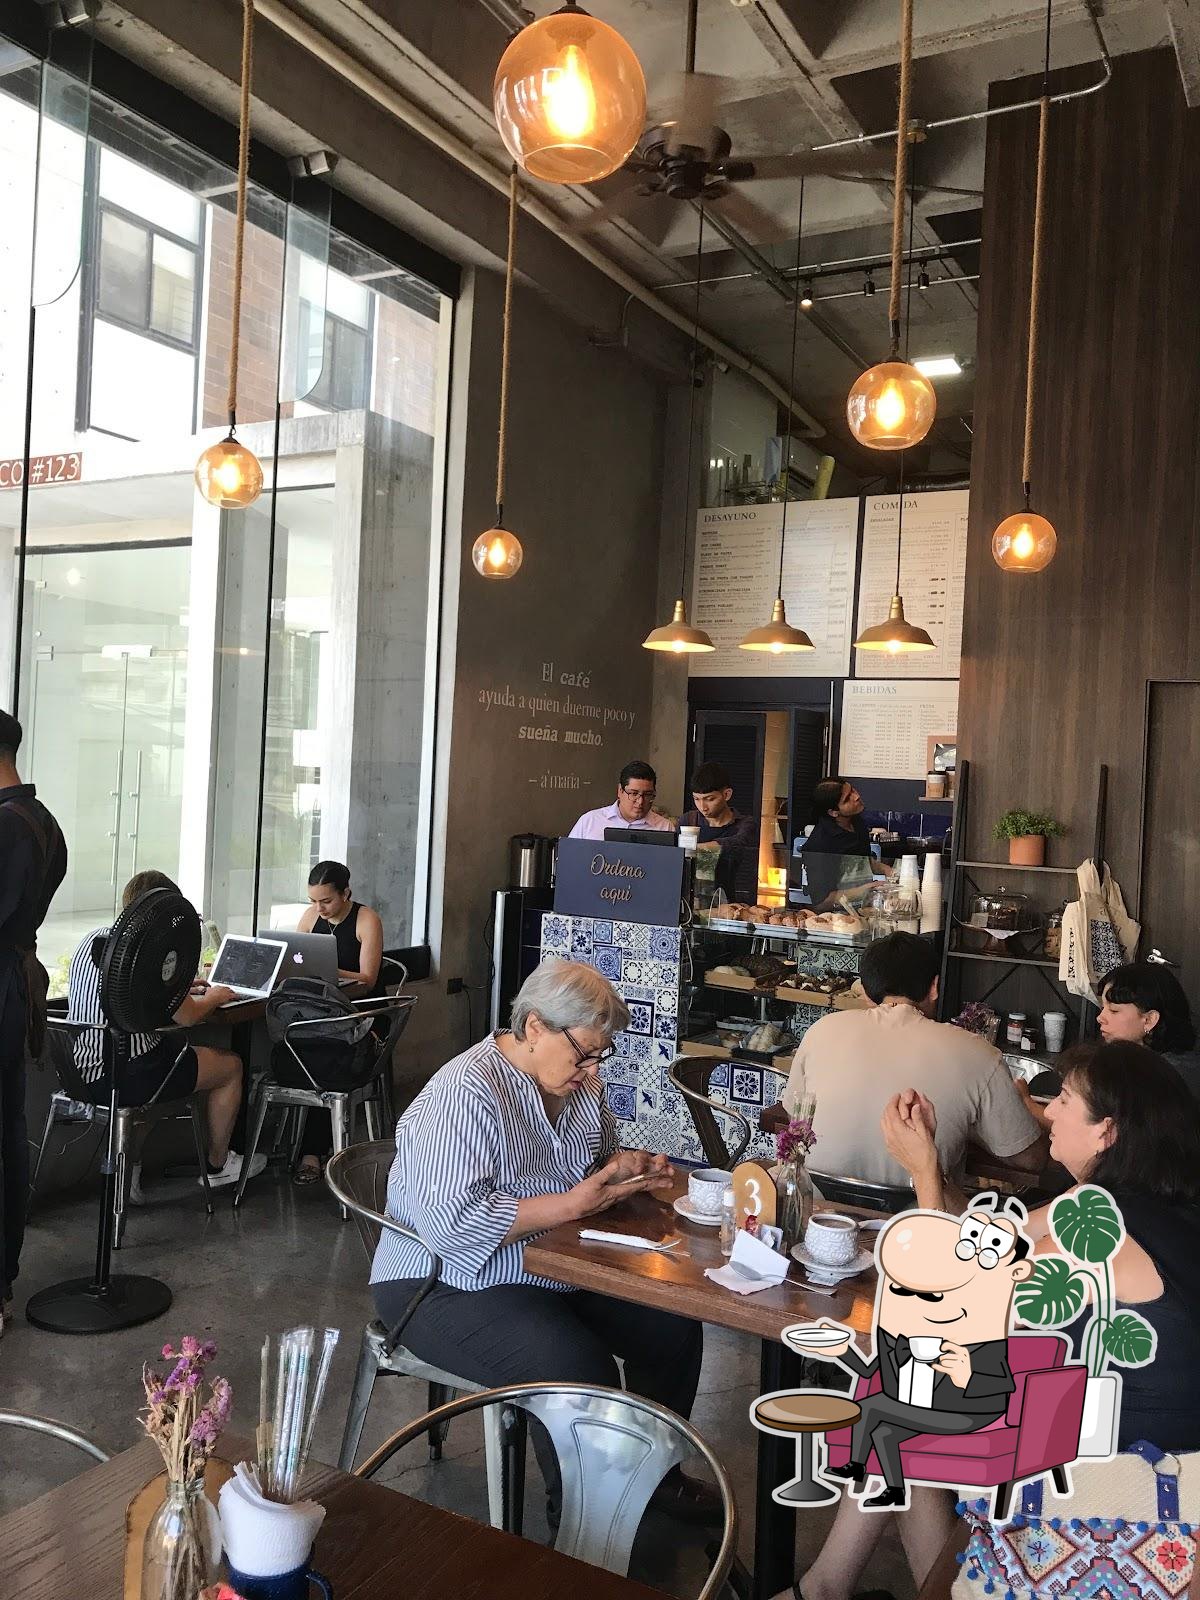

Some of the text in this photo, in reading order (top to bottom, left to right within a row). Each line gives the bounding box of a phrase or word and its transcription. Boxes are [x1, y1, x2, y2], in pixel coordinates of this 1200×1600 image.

[0, 453, 79, 485] CO #123
[704, 512, 757, 523] DESAYUNO
[873, 500, 919, 511] COMDA
[542, 662, 592, 688] El café
[852, 686, 897, 694] BEBIDAS
[478, 685, 635, 729] ayuda a quien duerme poco y
[518, 725, 604, 746] sueña mucho.
[590, 853, 646, 879] Ordena
[743, 1178, 762, 1216] 3
